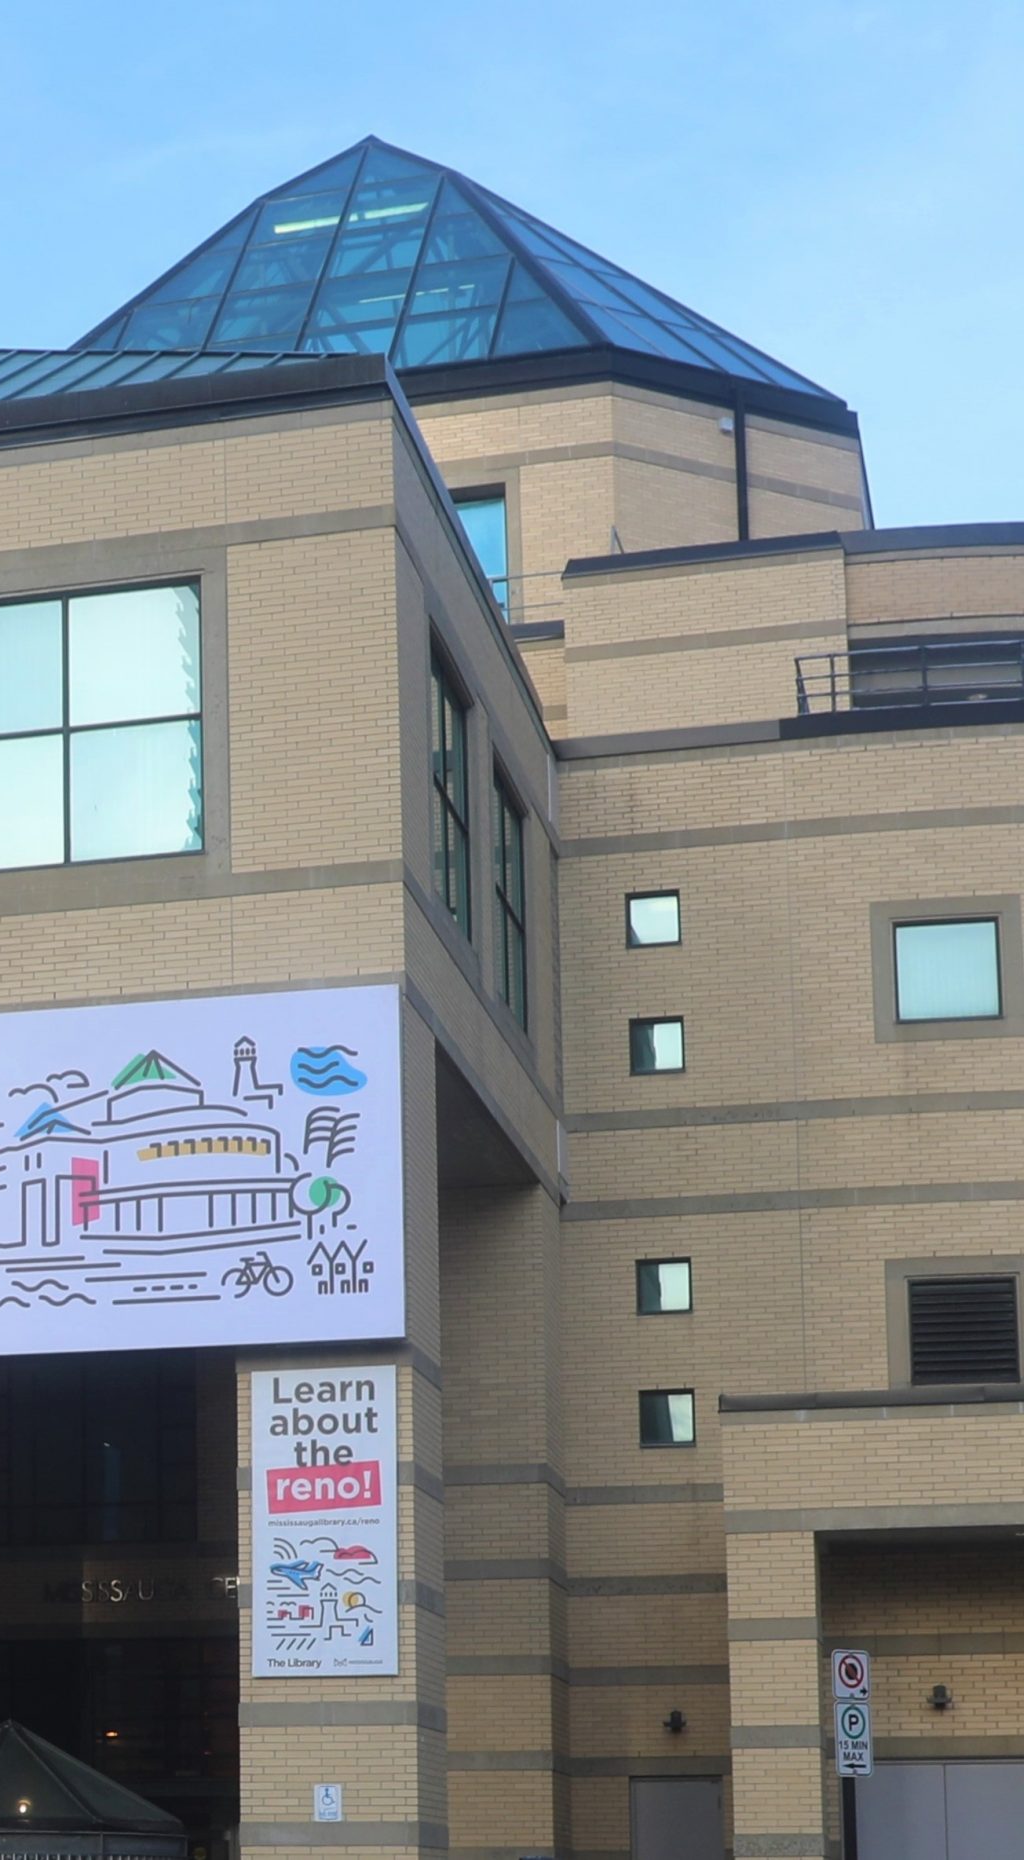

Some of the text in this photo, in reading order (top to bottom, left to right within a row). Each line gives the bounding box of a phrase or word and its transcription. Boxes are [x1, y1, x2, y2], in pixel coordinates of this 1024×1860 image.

[273, 1376, 375, 1404] Learn
[269, 1406, 379, 1437] about
[293, 1439, 354, 1468] the
[276, 1470, 372, 1501] reno!
[266, 1658, 322, 1669] The Library
[848, 1713, 860, 1731] P
[838, 1740, 868, 1750] 15 MIN
[842, 1751, 864, 1762] MAX
